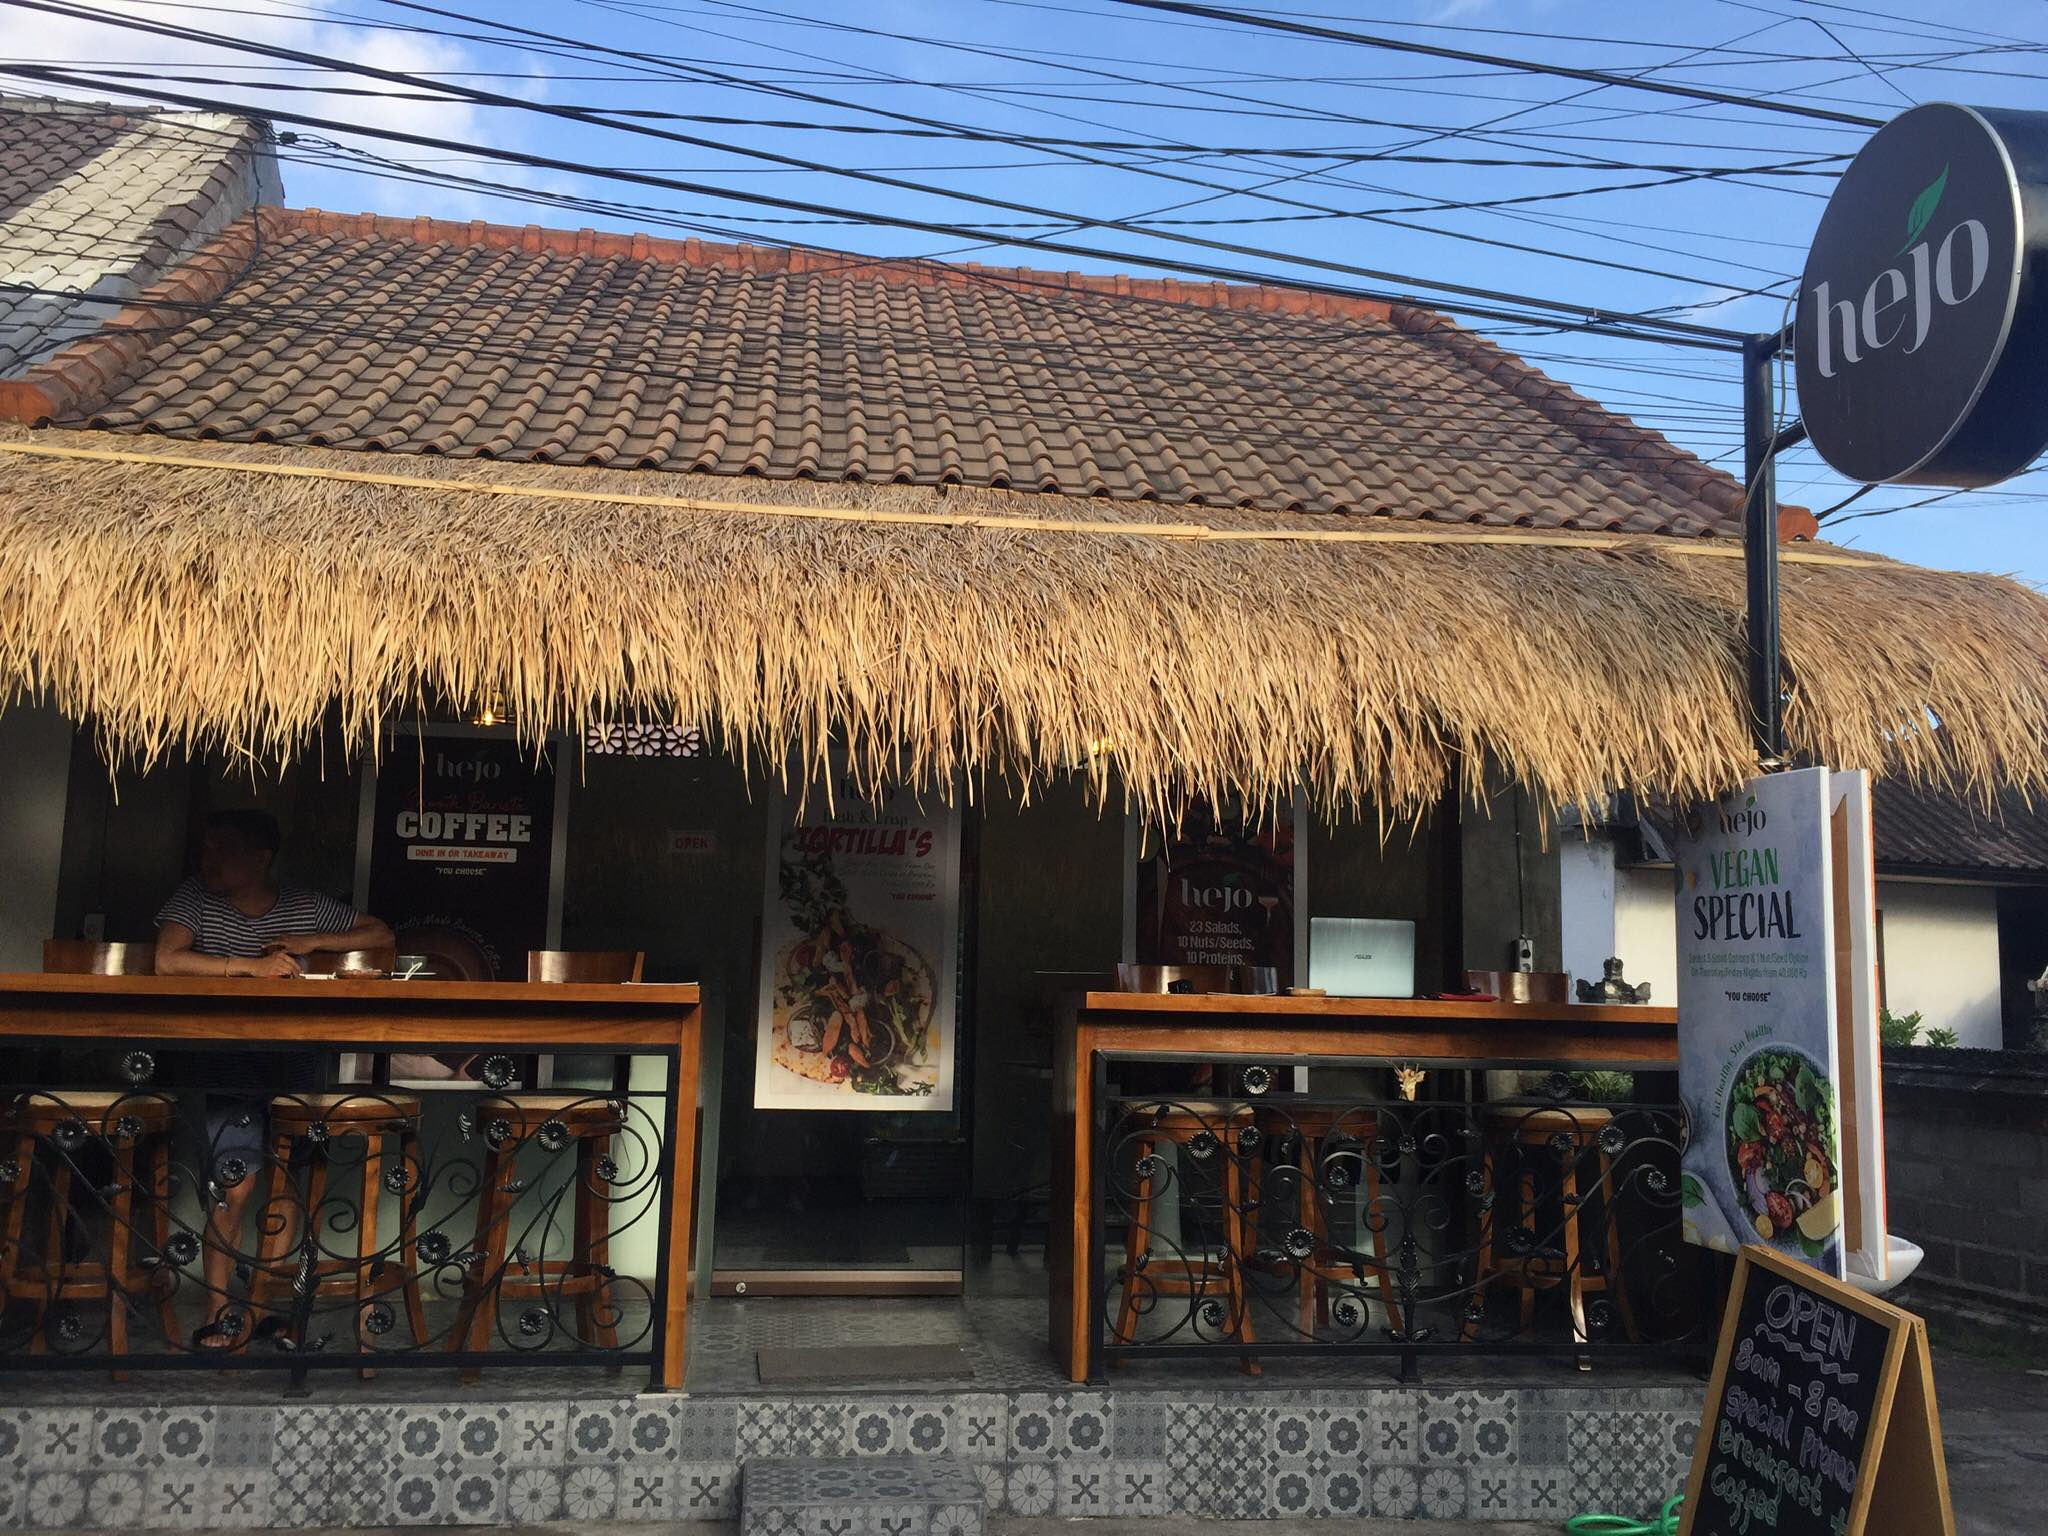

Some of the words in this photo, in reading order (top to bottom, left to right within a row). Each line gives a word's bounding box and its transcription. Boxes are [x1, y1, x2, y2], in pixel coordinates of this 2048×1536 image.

[1813, 218, 1990, 378] hejo
[436, 752, 501, 783] hejo
[396, 811, 532, 843] COFFEE
[675, 837, 709, 850] OPEN
[797, 825, 933, 858] TORTILLA'S
[415, 849, 434, 857] DINE
[449, 850, 460, 858] OR
[463, 850, 509, 860] TAKEAWAY
[1710, 847, 1779, 890] VEGAN
[1180, 878, 1253, 913] hejo
[1189, 920, 1203, 934] 23
[1693, 890, 1802, 941] SPECIAL
[1177, 935, 1188, 948] 10
[1186, 951, 1198, 964] 10
[1764, 1284, 1857, 1361] OPEN
[1725, 1384, 1795, 1450] Special
[1718, 1418, 1823, 1517] Breakfast
